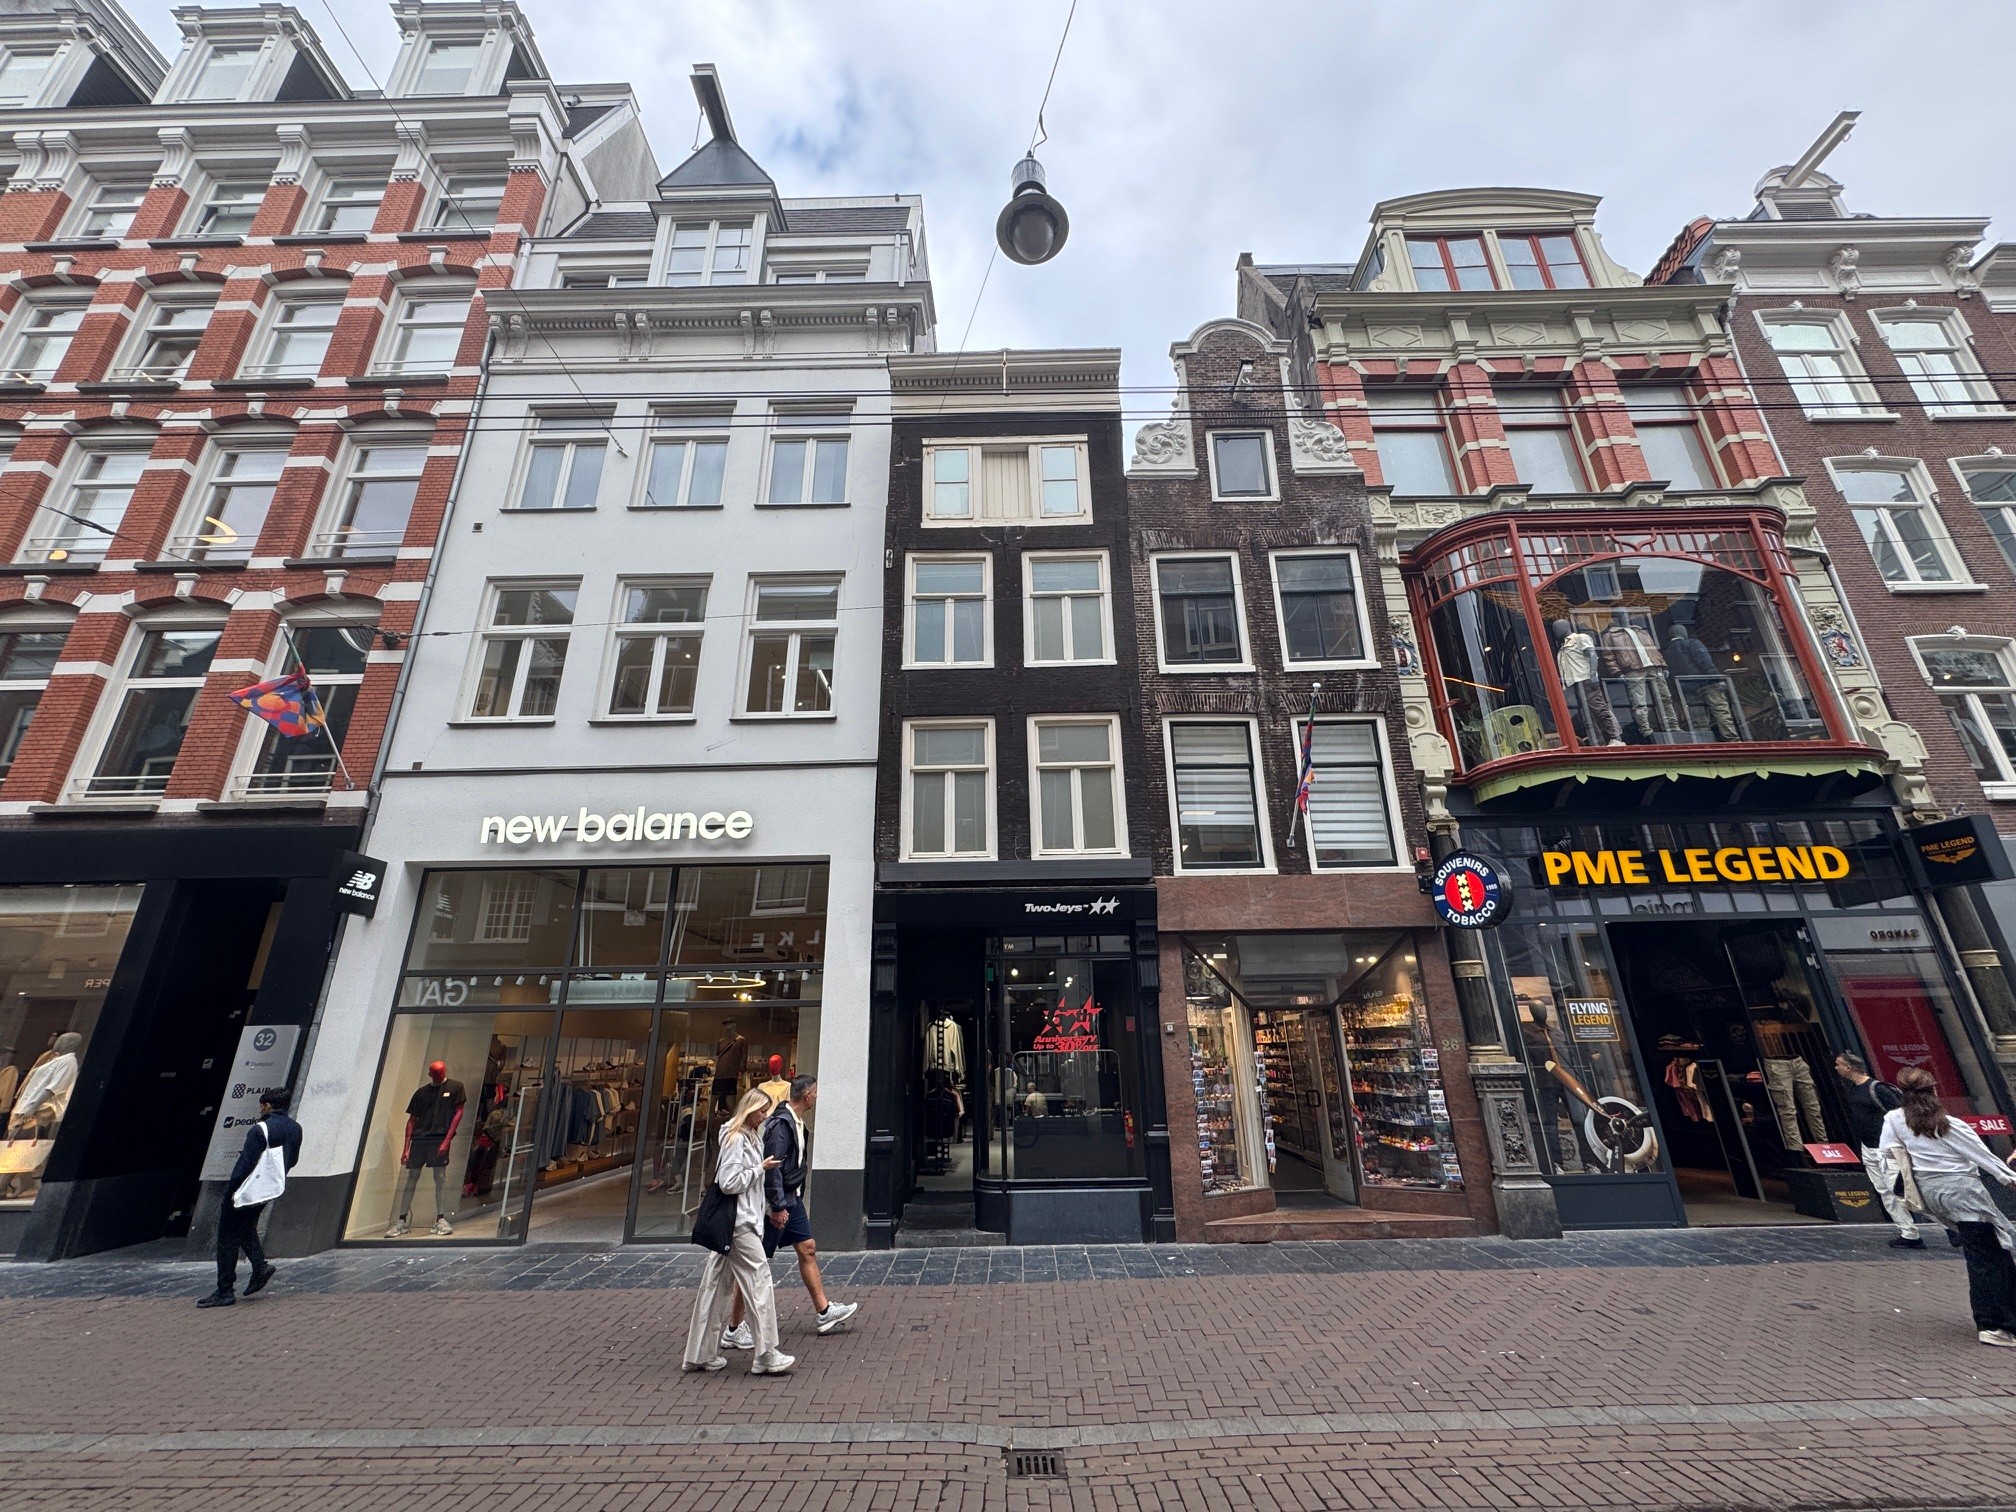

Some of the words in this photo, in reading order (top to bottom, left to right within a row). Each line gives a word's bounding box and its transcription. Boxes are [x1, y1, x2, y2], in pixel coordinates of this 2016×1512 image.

[480, 815, 568, 844] new
[576, 805, 753, 842] balance
[1921, 843, 1940, 853] PME
[1940, 836, 1975, 848] LEGEND
[1435, 857, 1489, 886] SOUVENIRS
[1542, 850, 1650, 885] PME
[1658, 845, 1850, 883] LEGEND
[339, 886, 351, 896] new
[351, 889, 375, 900] balance
[1024, 903, 1083, 914] TwoJeys
[1446, 900, 1496, 925] TOBACCO
[1568, 1002, 1609, 1014] FLYING
[1571, 1014, 1611, 1026] LEGEND
[255, 1033, 275, 1046] 32
[1441, 1038, 1460, 1051] 26
[234, 1117, 261, 1127] peak
[1979, 1119, 2007, 1130] SALE
[1821, 1150, 1844, 1158] SALE
